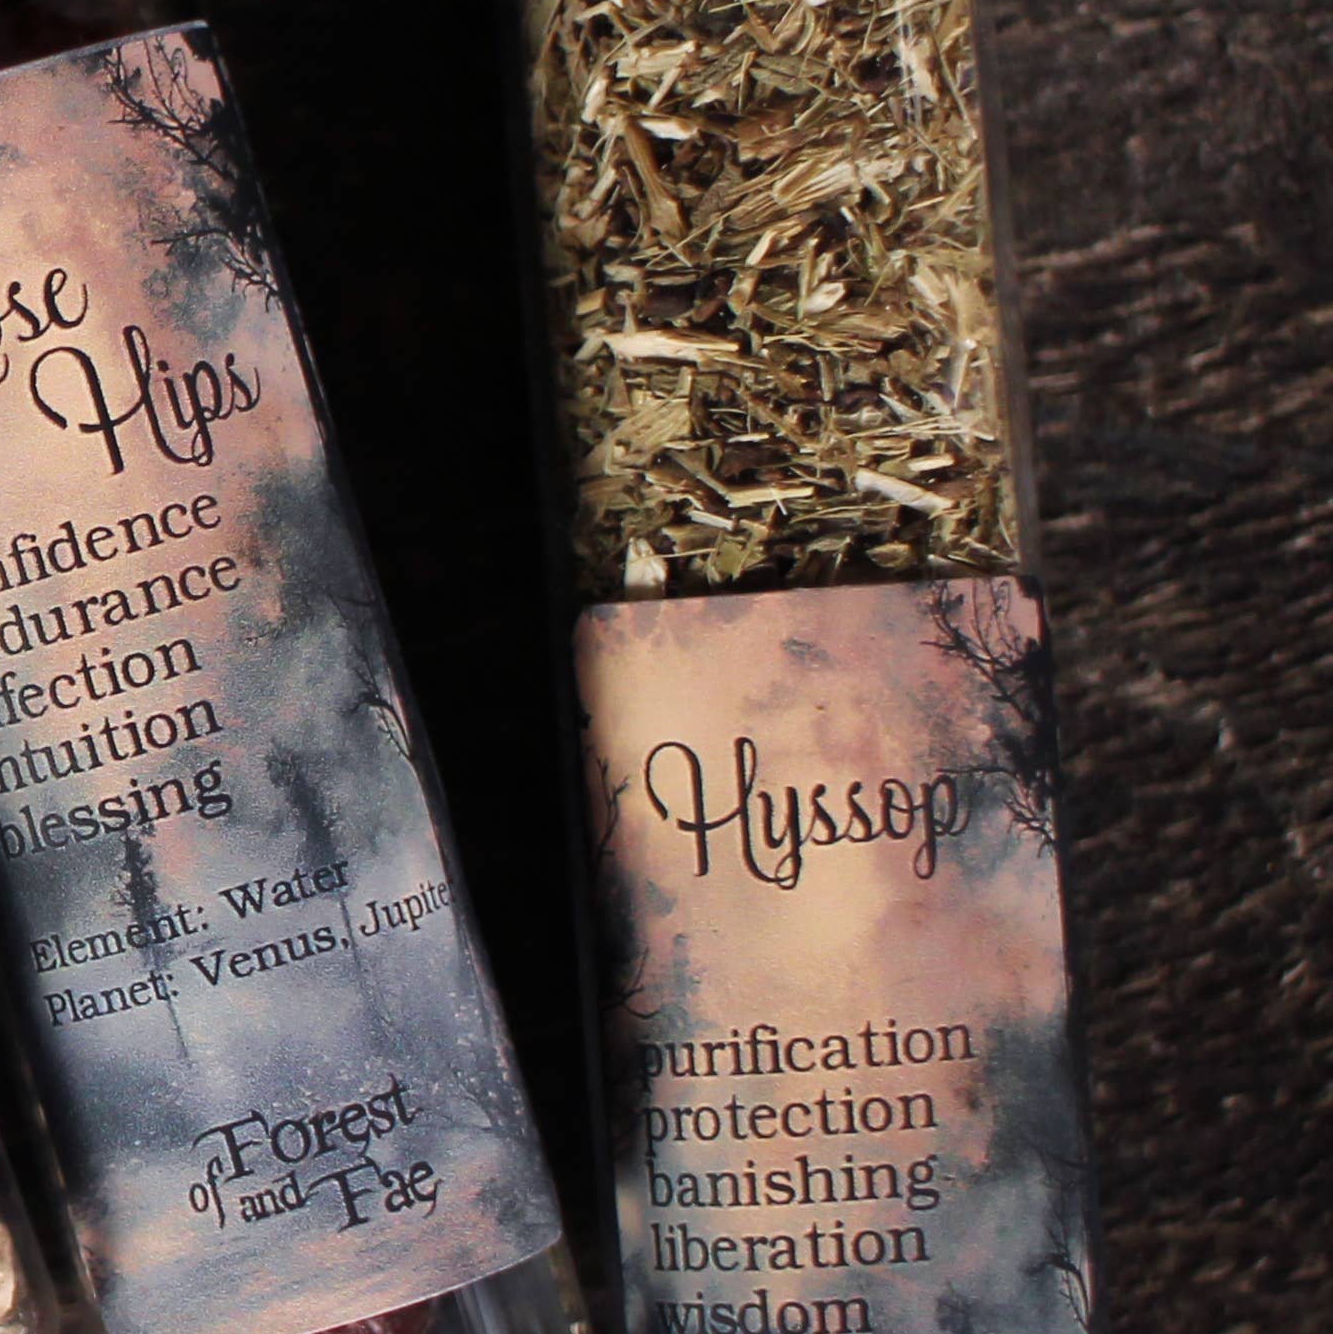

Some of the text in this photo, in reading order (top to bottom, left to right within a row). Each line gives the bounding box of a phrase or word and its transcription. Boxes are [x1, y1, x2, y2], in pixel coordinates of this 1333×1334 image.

[30, 324, 261, 475] Hips
[643, 737, 971, 890] Hyssop
[30, 904, 210, 974] Element:
[44, 969, 179, 1028] Planet:
[187, 921, 350, 986] Venus,
[638, 1020, 979, 1093] purification
[188, 1074, 423, 1229] of Forest
[643, 1086, 938, 1157] protection
[240, 1155, 442, 1233] and Fae
[645, 1153, 940, 1210] banishing
[651, 1220, 930, 1272] liberation
